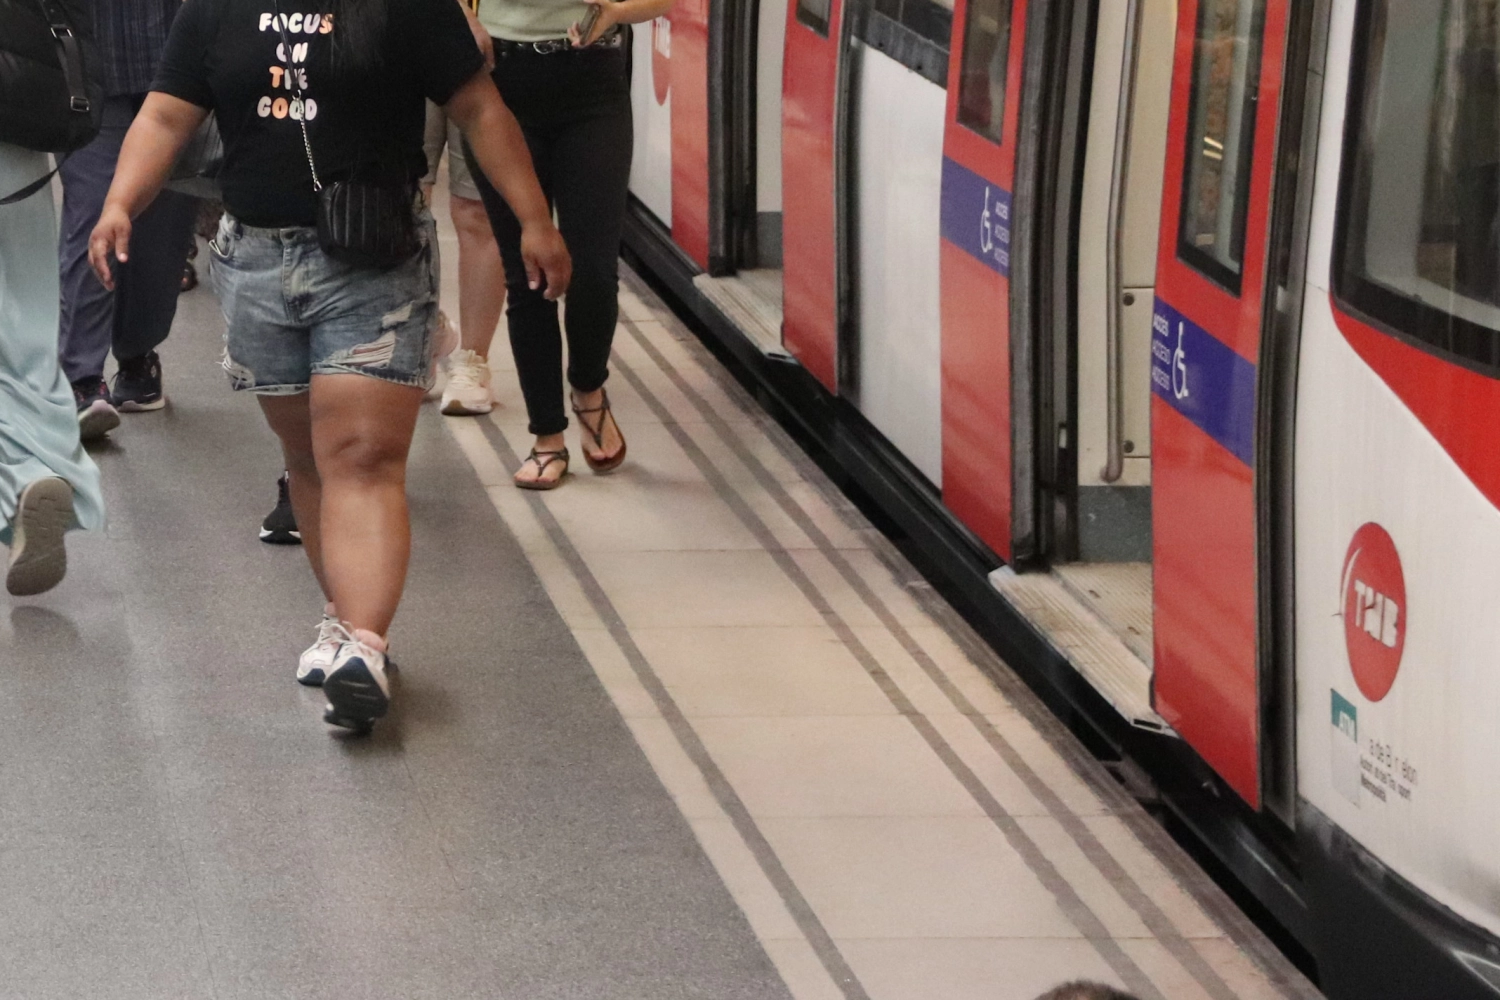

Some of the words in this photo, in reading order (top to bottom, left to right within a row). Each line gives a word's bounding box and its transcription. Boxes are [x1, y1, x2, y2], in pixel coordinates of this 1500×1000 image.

[258, 12, 334, 34] FOCUS
[275, 42, 309, 64] ON
[269, 65, 309, 90] THE
[256, 95, 318, 121] GOOD
[1354, 579, 1399, 648] TMB
